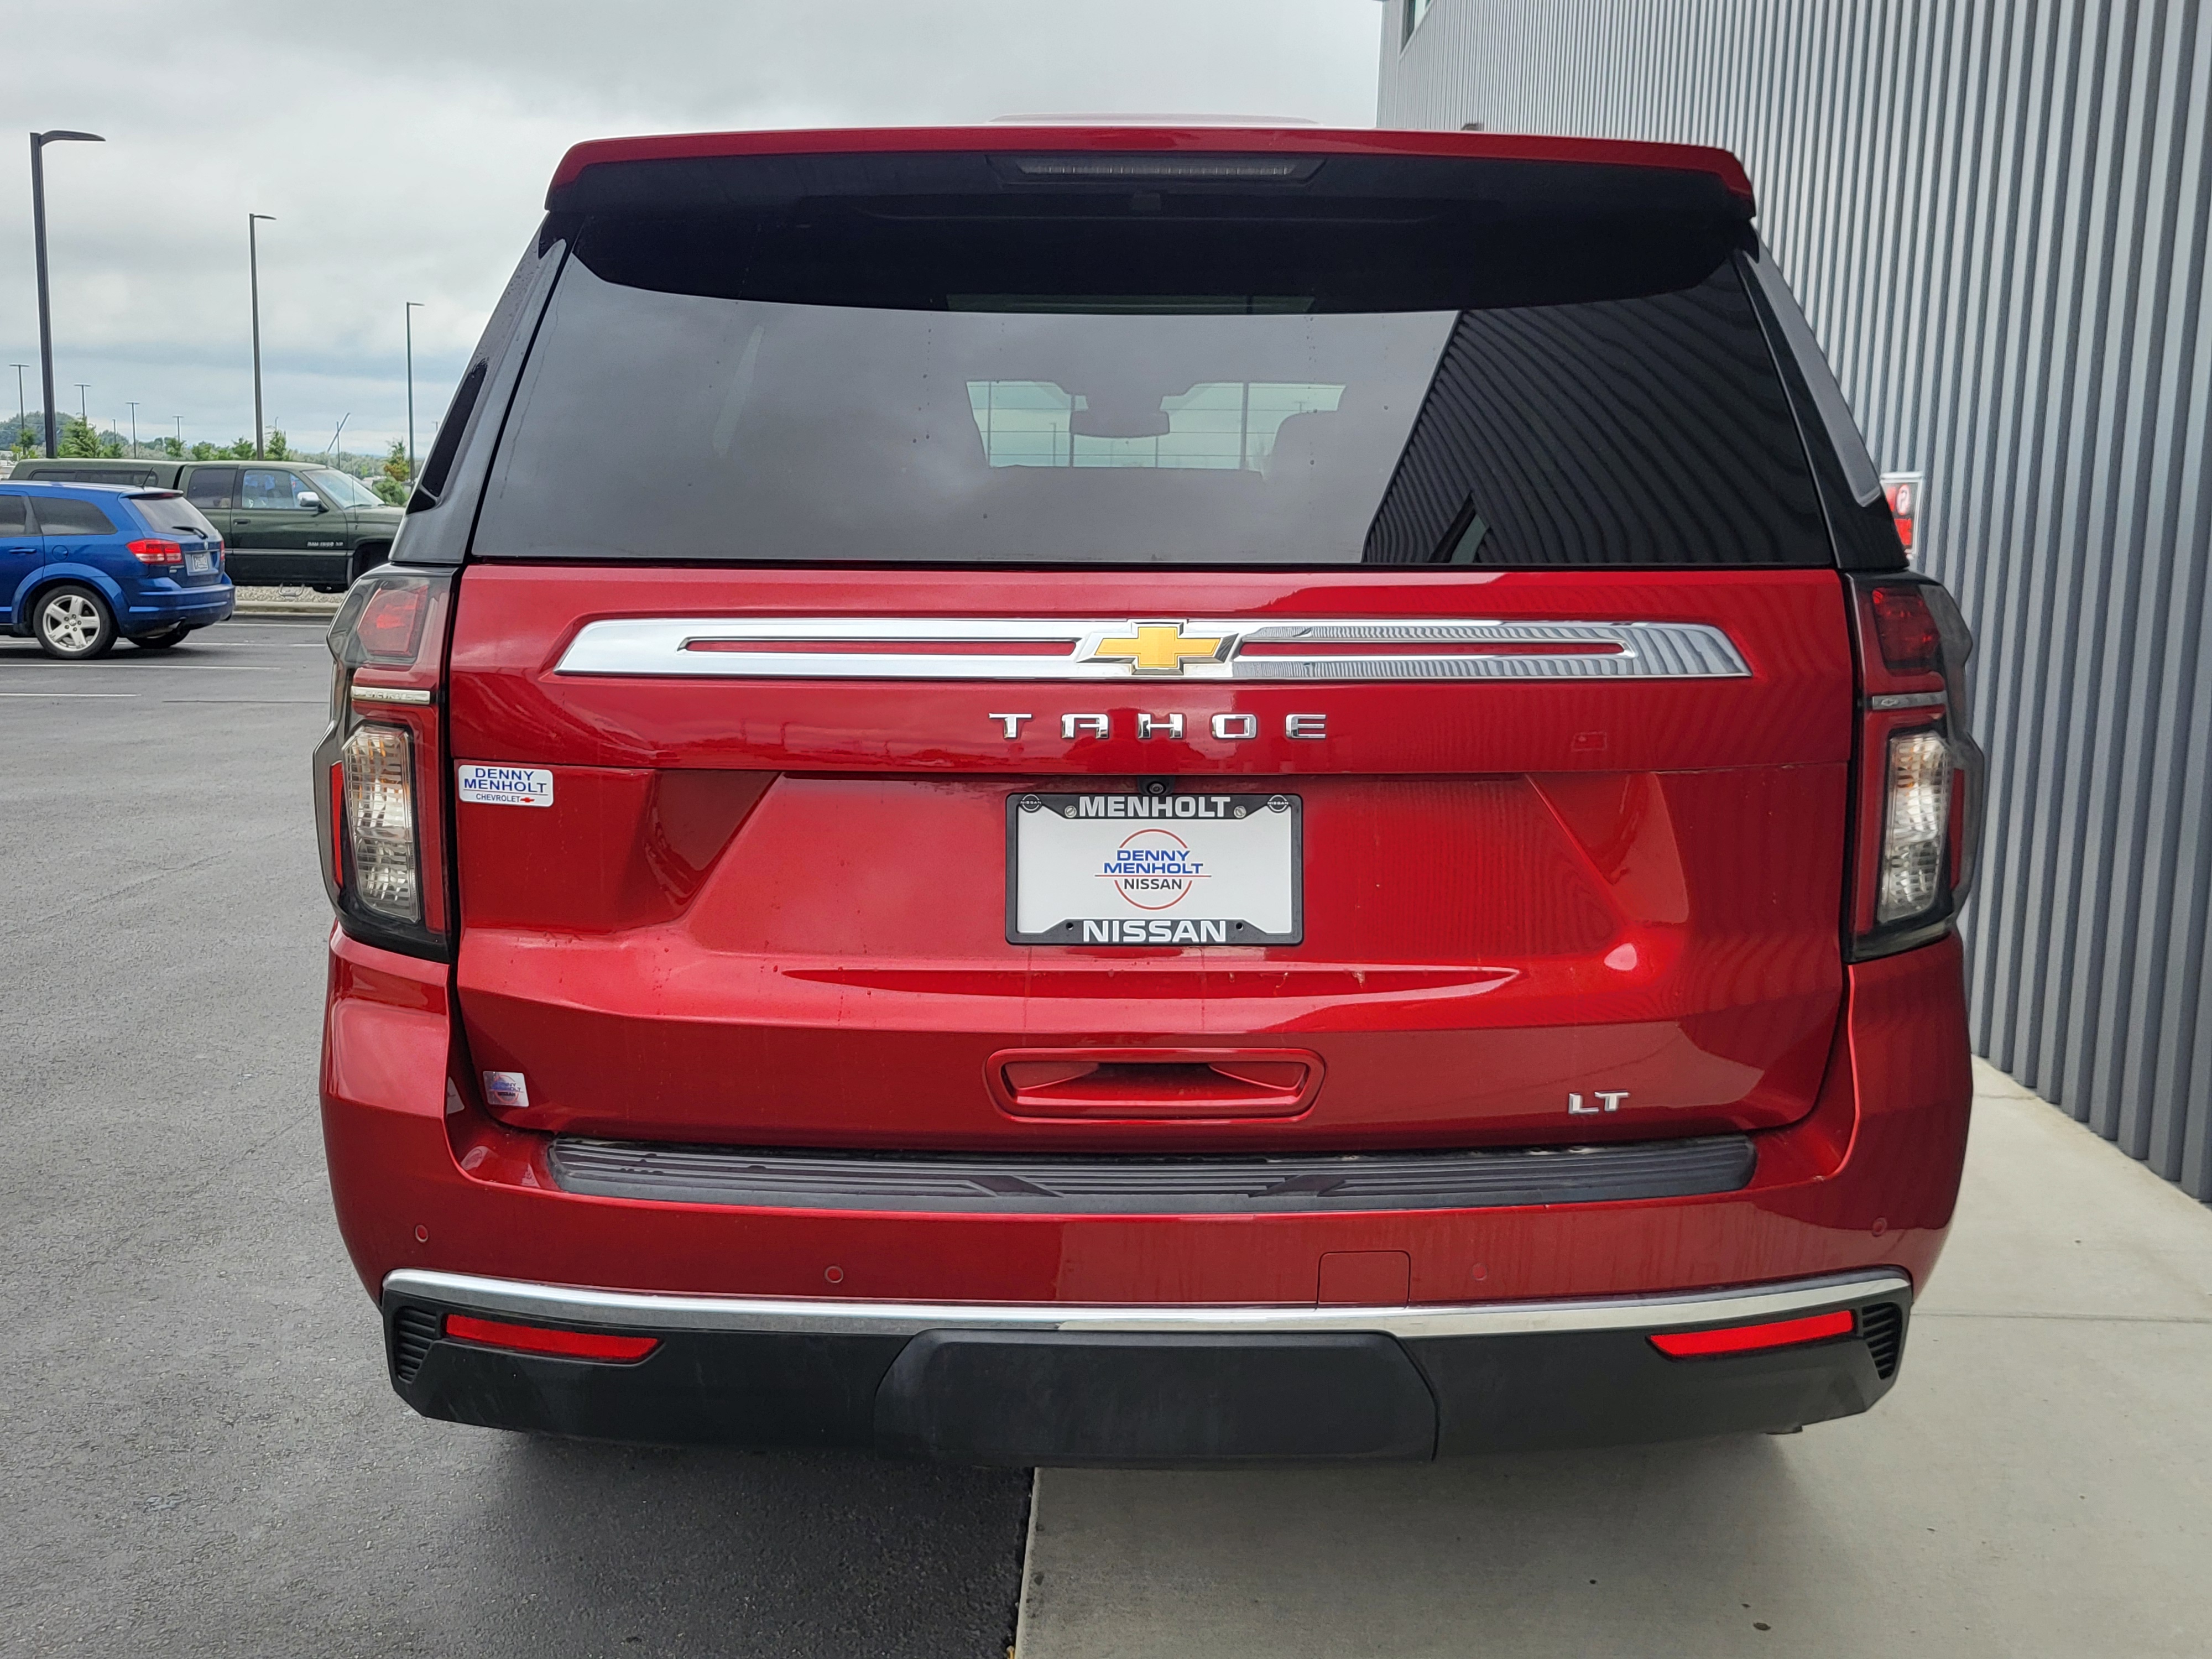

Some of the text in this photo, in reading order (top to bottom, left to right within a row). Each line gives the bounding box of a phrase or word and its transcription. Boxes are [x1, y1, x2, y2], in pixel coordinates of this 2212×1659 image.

[989, 713, 1327, 739] TAHOE
[475, 767, 535, 781] DENNY
[463, 778, 547, 793] MENHOLT
[476, 793, 521, 802] CHEVROLET
[1079, 796, 1231, 817] MENHOLT
[1117, 849, 1191, 862] DENNY
[1104, 862, 1204, 874] MENHOLT
[1124, 878, 1182, 890] NISSAN
[1083, 920, 1226, 943] NISSAN
[1568, 1090, 1631, 1115] LT
